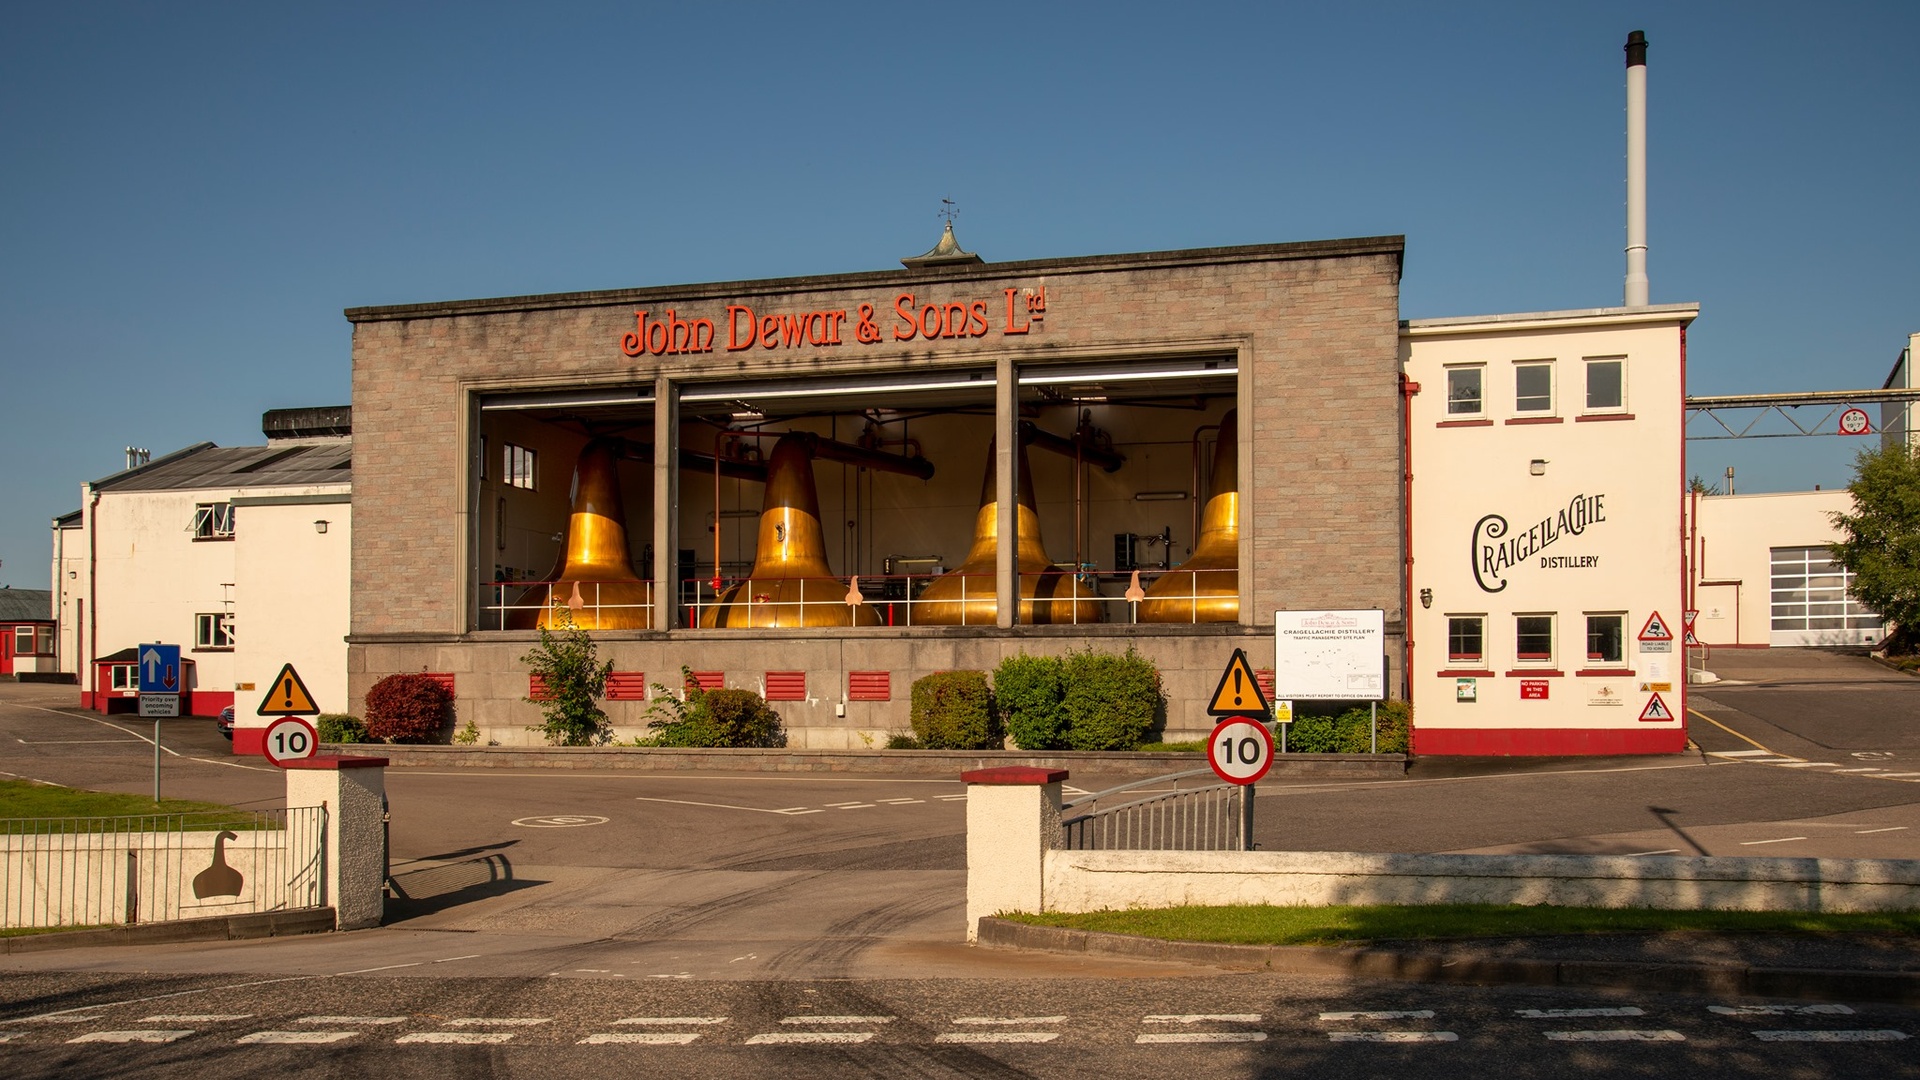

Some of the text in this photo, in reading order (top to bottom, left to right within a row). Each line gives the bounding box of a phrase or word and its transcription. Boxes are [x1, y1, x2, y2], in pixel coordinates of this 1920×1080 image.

[620, 285, 1046, 357] John Dewar & Sons Ltd
[1471, 493, 1606, 594] CRAIGELLACHIE
[1541, 556, 1599, 569] DISTILLERY
[275, 731, 307, 754] 10
[1222, 737, 1260, 765] 10
